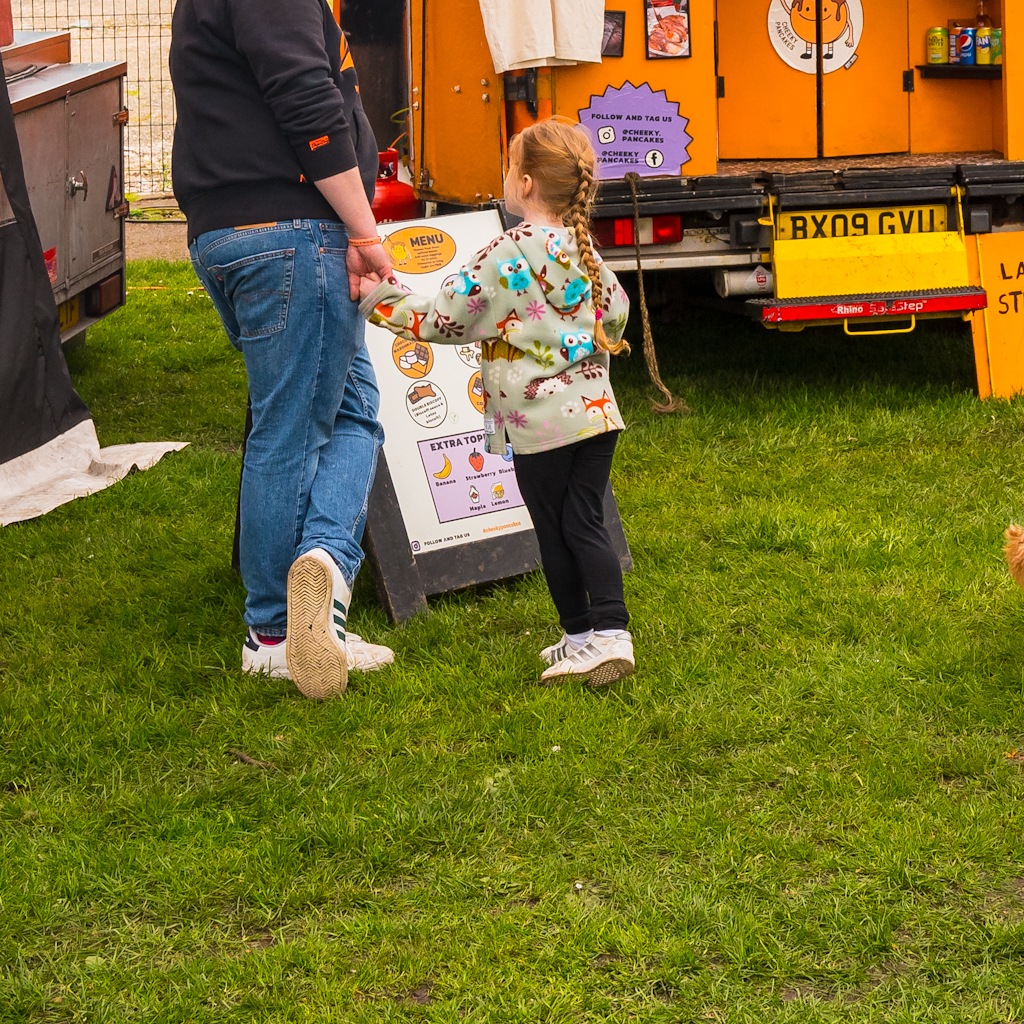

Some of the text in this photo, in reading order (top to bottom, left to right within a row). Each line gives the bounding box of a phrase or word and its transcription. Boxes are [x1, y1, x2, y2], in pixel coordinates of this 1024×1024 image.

[775, 21, 796, 51] PANCAKES
[782, 21, 799, 44] CHEEKY
[622, 129, 661, 137] @CHEEKY.
[790, 208, 935, 240] BX09 GVU
[410, 233, 444, 247] MENU
[837, 305, 863, 314] Rhino
[430, 438, 464, 452] EXTRA
[465, 470, 497, 482] Strawberry
[498, 466, 515, 474] Blueb
[435, 478, 457, 487] Banana
[469, 503, 487, 513] Maple
[491, 498, 510, 507] Lemon
[423, 539, 443, 547] FOLLOW
[454, 533, 463, 541] TAG
